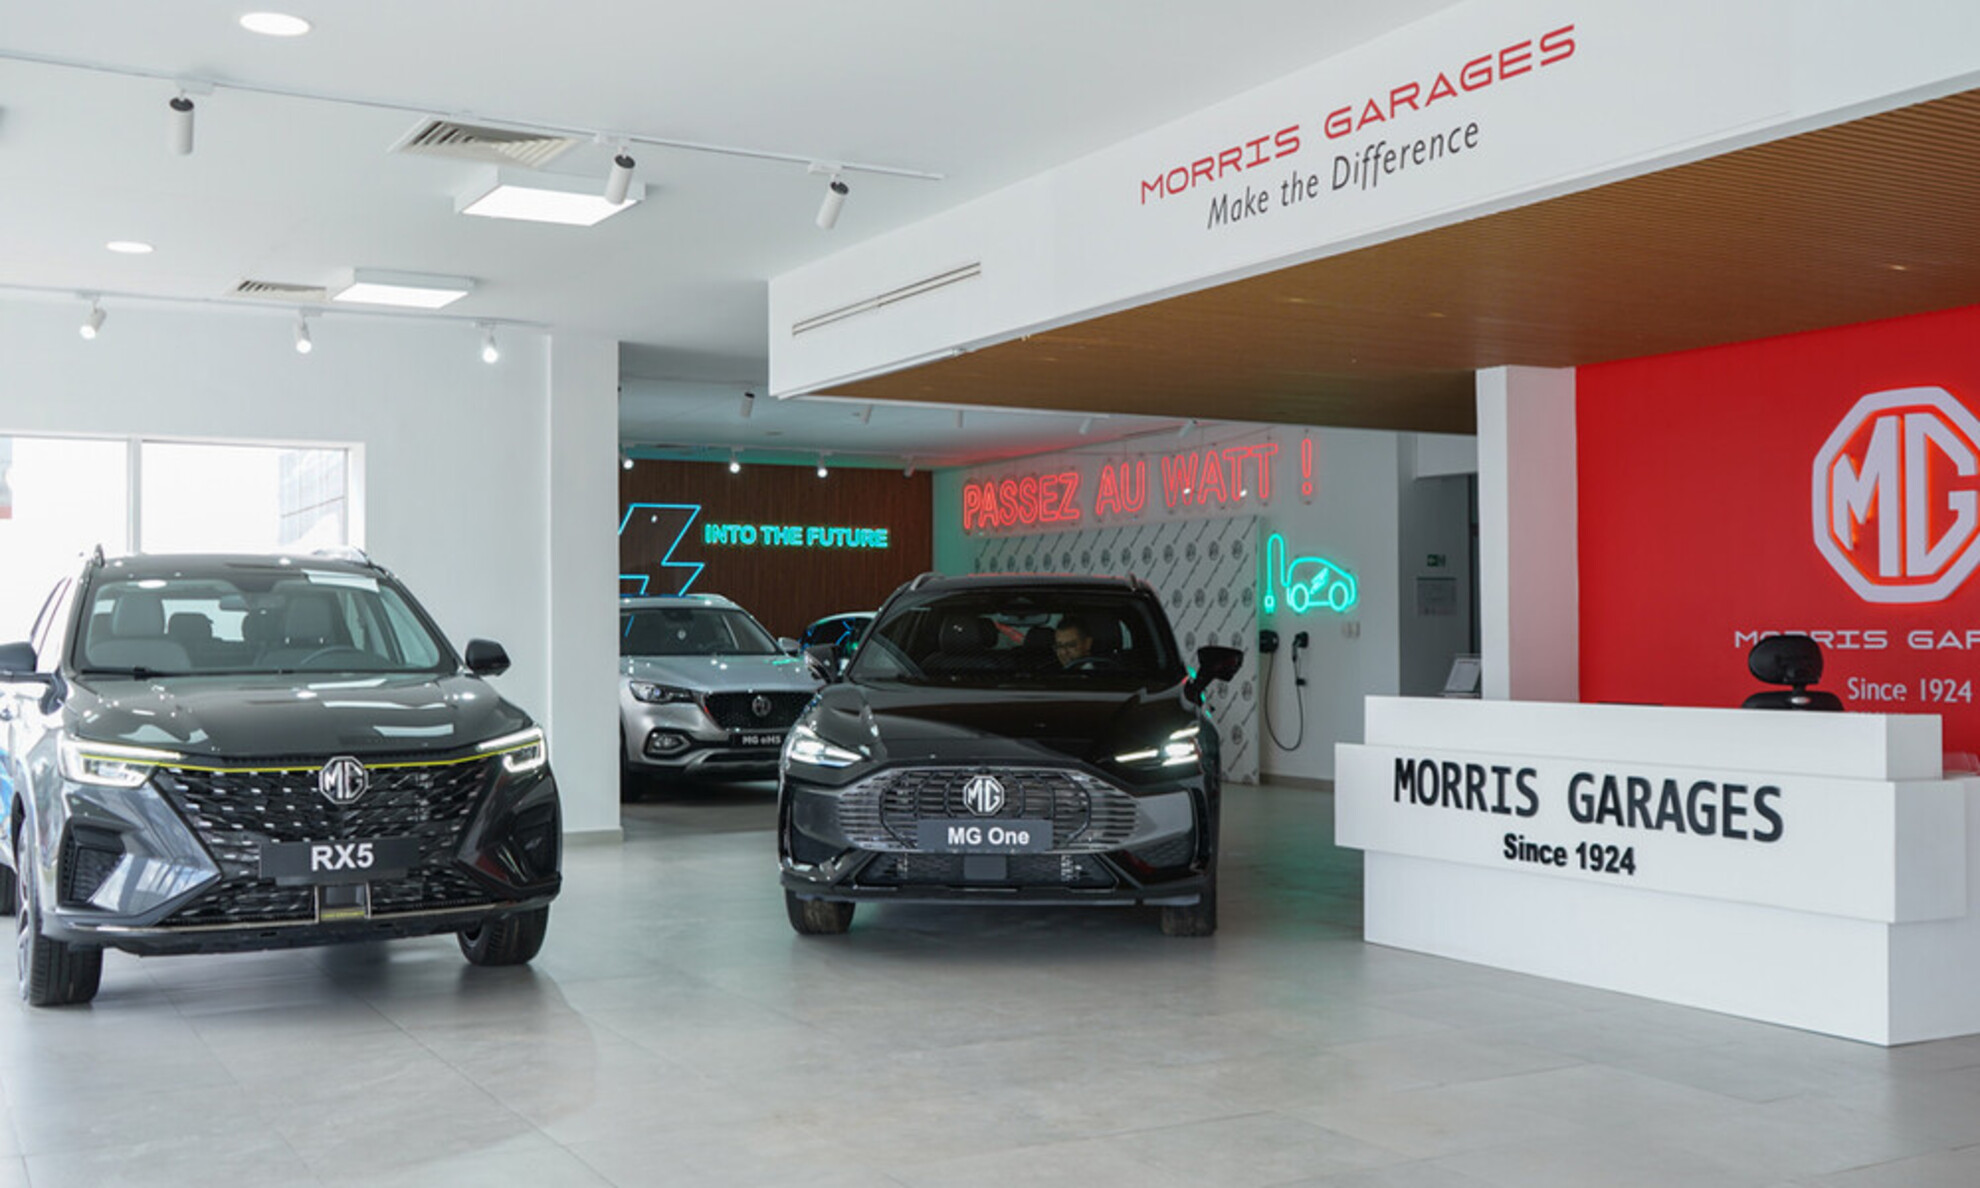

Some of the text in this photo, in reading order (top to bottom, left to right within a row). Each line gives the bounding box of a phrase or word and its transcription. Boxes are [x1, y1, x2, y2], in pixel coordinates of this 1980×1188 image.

[1141, 24, 1576, 204] MORRIS GARAGES
[1207, 122, 1480, 230] Make the Difference
[963, 471, 1081, 530] PASSEZ
[1095, 460, 1147, 516] AU
[1161, 442, 1279, 508] WATT
[1831, 411, 1979, 579] MG
[704, 523, 889, 549] INTO THE FUTURE
[1847, 676, 1973, 703] Since 1924
[322, 759, 366, 801] MG
[965, 777, 1002, 814] MG
[1393, 757, 1784, 843] MORRIS GARAGES
[311, 843, 374, 871] RX5
[947, 826, 1030, 845] MG One
[1503, 832, 1637, 876] Since 1924
